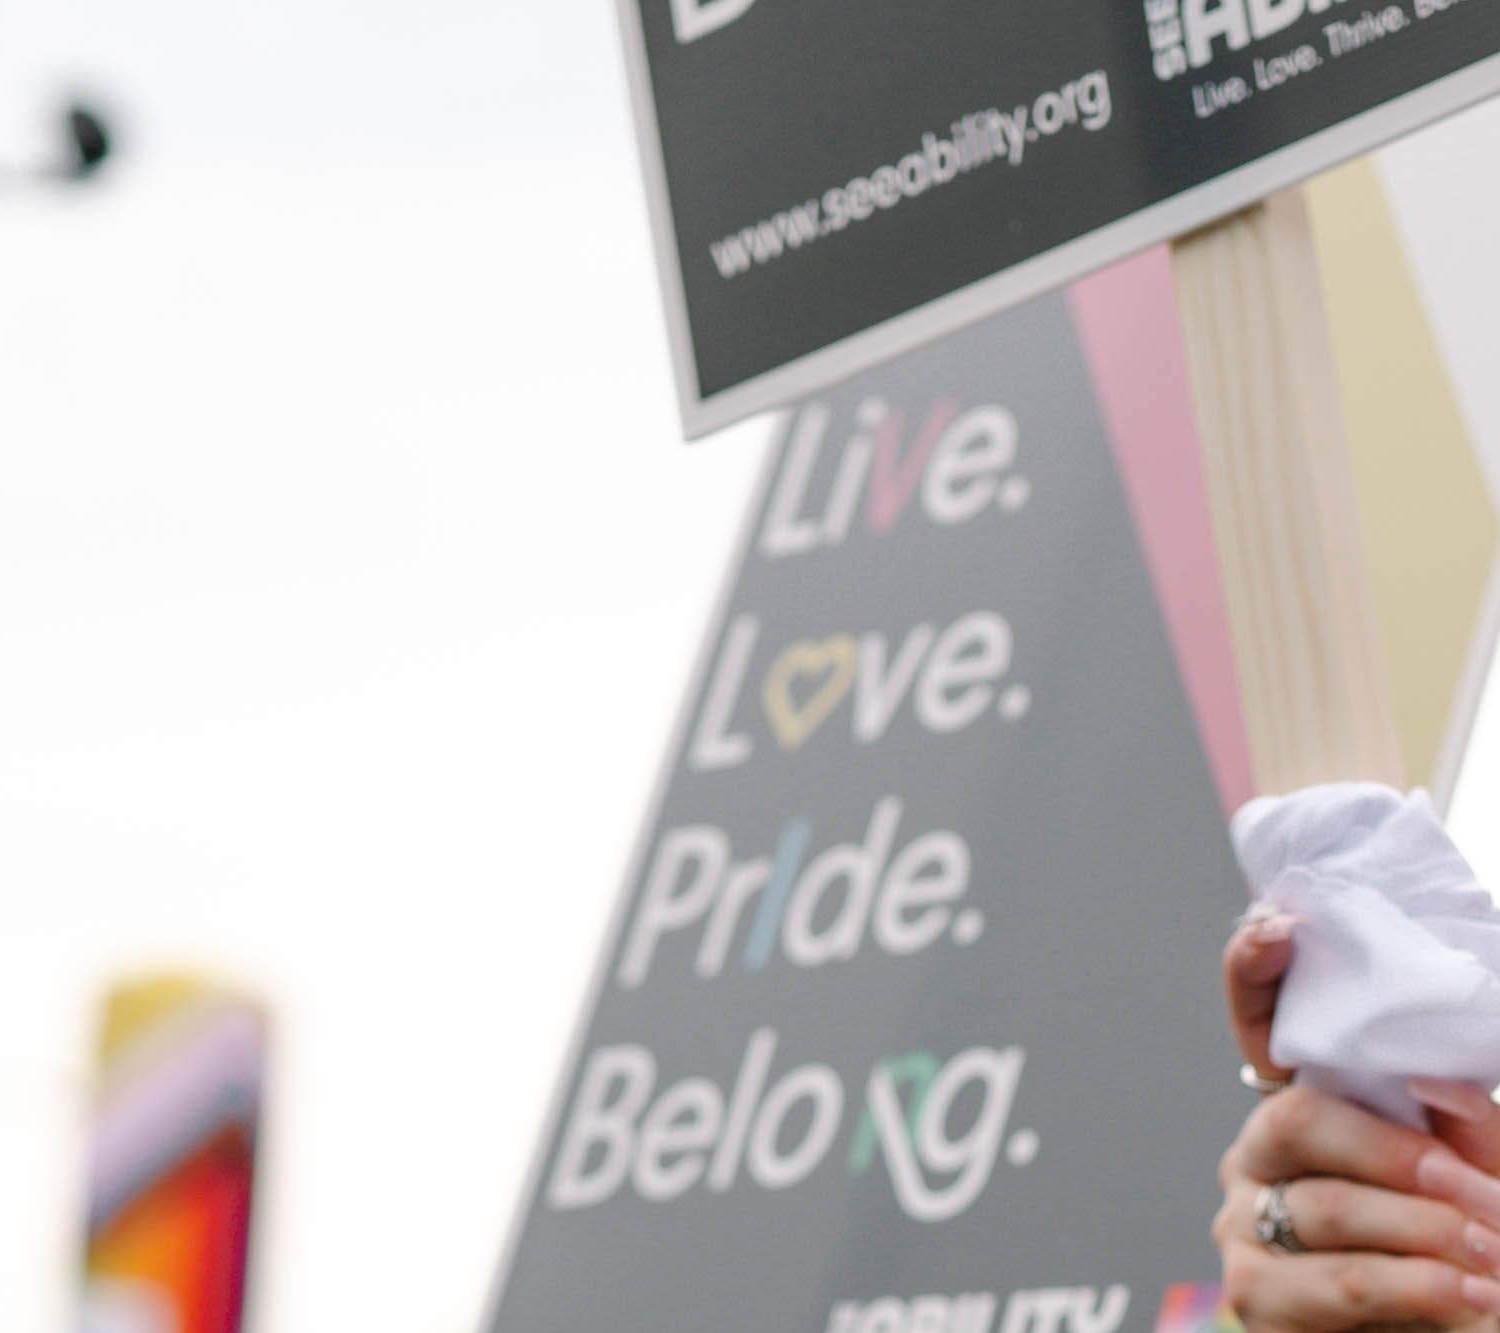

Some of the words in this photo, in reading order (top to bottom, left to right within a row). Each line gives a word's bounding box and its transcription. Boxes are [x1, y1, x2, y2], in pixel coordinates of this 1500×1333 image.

[1192, 77, 1253, 118] Live.
[1253, 45, 1323, 90] Love.
[1323, 5, 1411, 57] Thrive.
[710, 68, 1113, 279] www.seeability.org
